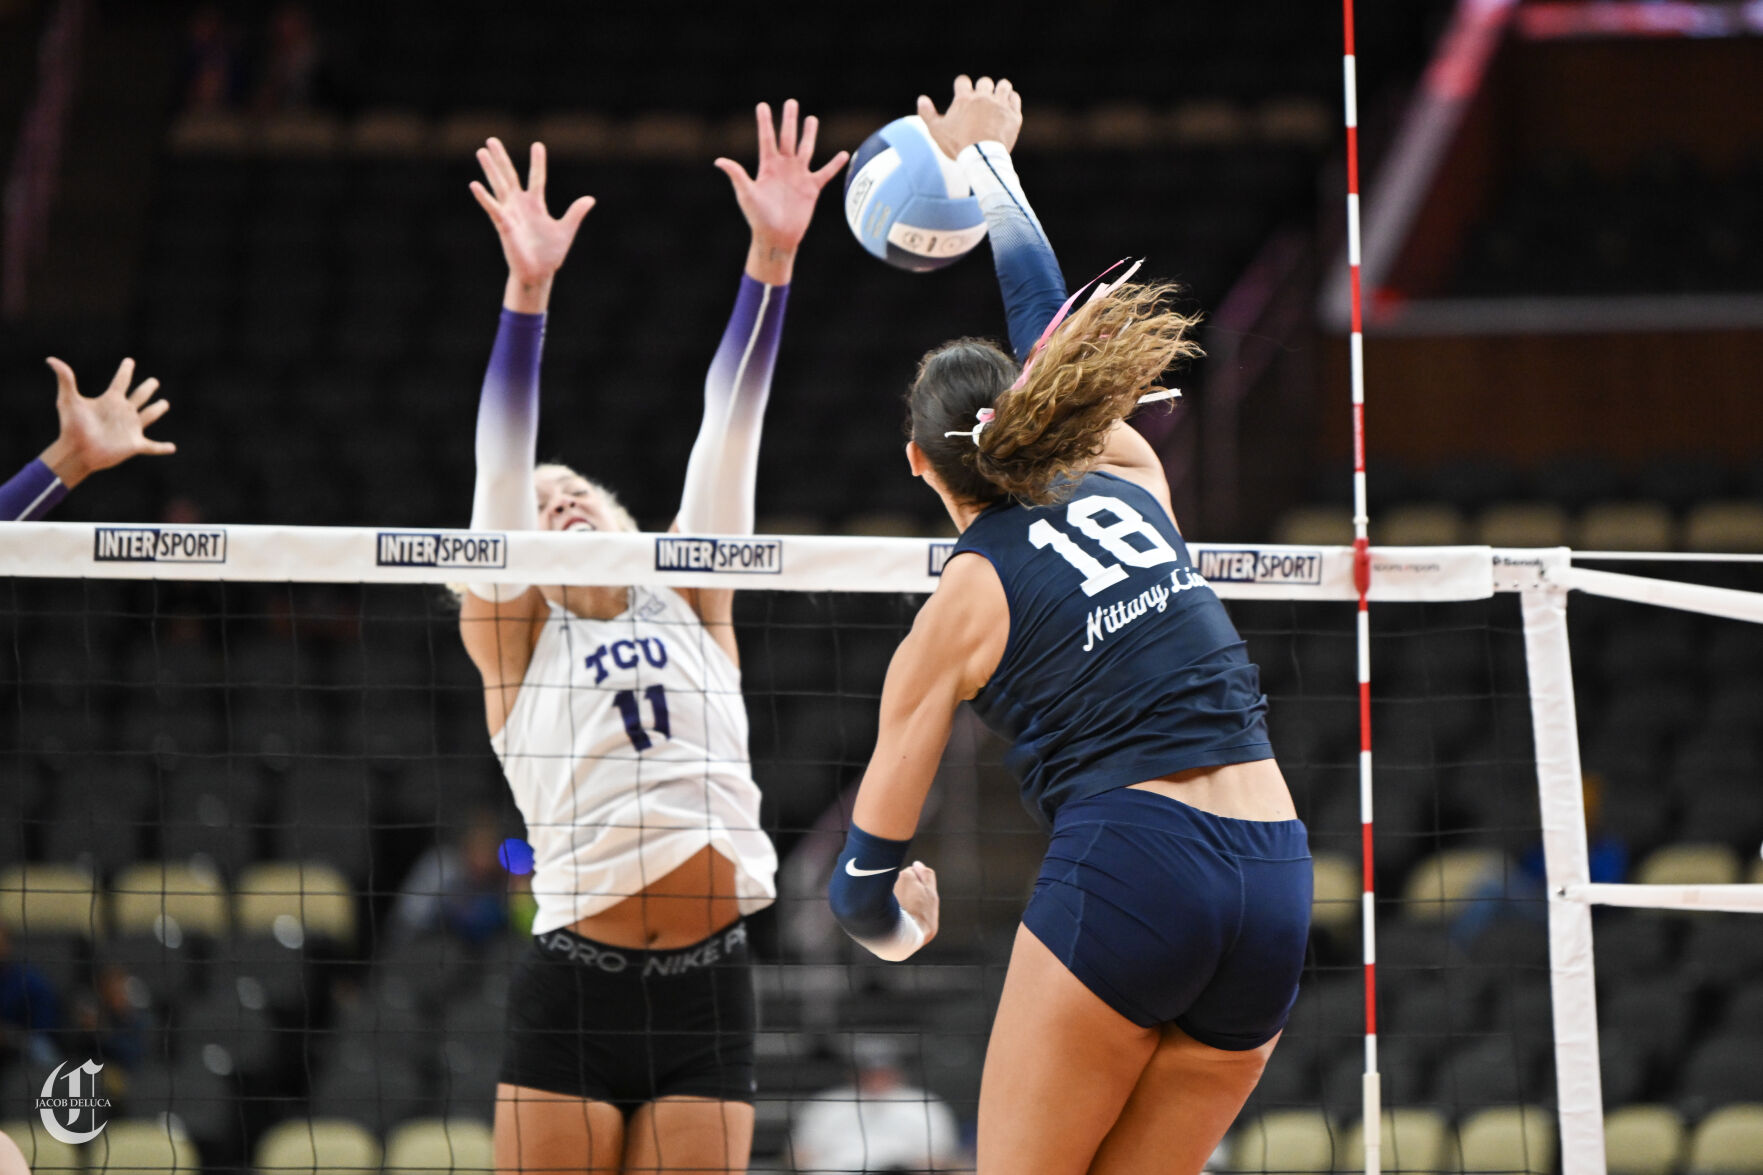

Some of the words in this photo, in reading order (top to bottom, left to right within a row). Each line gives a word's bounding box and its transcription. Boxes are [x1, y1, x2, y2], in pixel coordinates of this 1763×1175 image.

[1028, 494, 1177, 597] 18
[1083, 584, 1169, 651] Nittany
[584, 637, 668, 686] TCU
[613, 683, 671, 753] 11
[549, 932, 627, 973] PRO
[643, 940, 721, 977] NIKE
